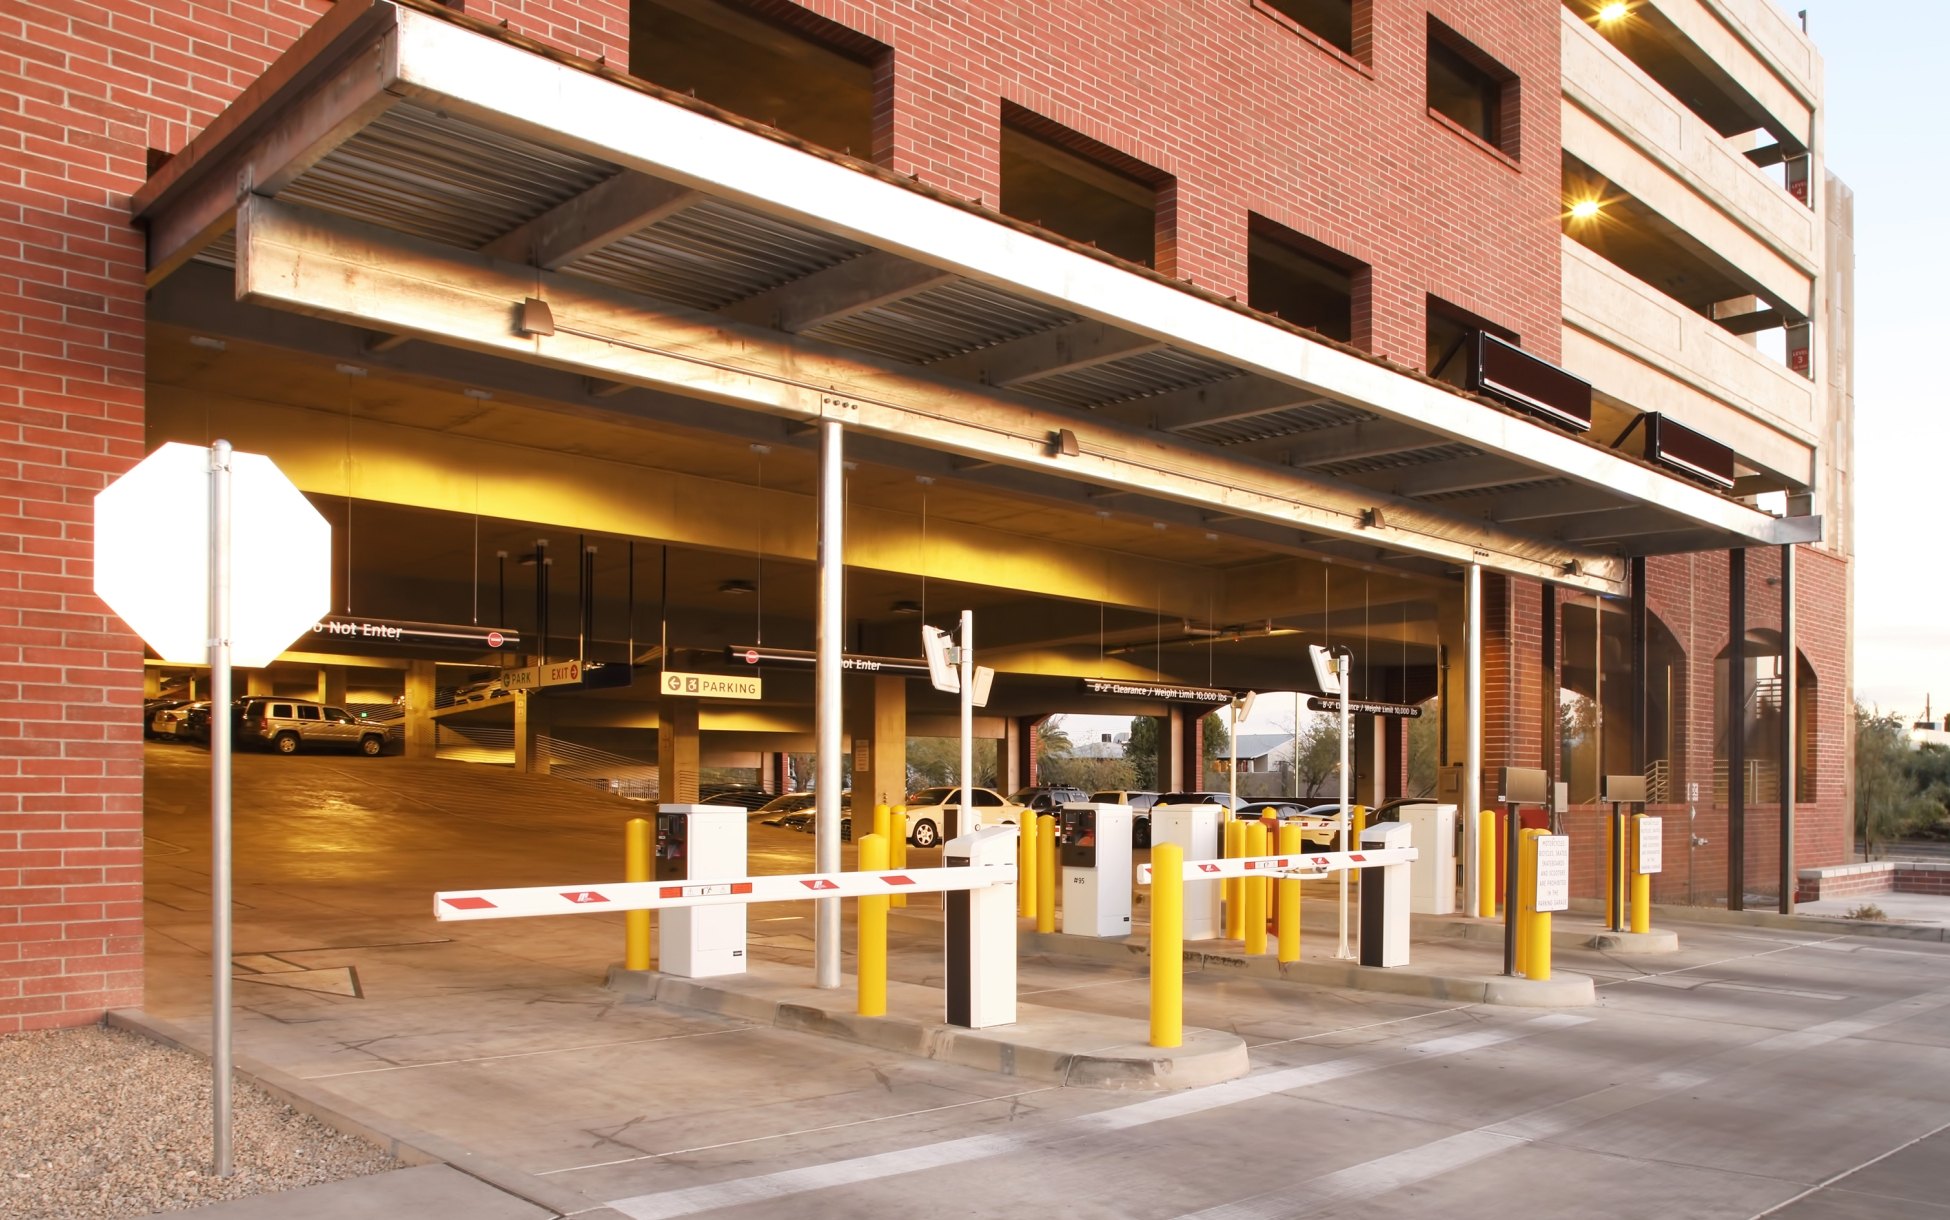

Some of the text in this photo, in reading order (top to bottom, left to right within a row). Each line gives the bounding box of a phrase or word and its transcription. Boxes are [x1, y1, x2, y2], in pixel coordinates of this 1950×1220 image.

[1797, 356, 1803, 364] 3
[313, 621, 402, 638] o Not Enter
[856, 660, 881, 670] Enter
[512, 672, 531, 684] PARK
[552, 667, 568, 680] EXIT
[703, 681, 756, 694] PARKING
[1113, 685, 1147, 695] Clearance
[1154, 688, 1177, 698] Weight
[1179, 690, 1194, 698] Limit
[1196, 692, 1216, 700] 10,000
[1218, 693, 1227, 701] lbs
[1364, 704, 1381, 714] Weight
